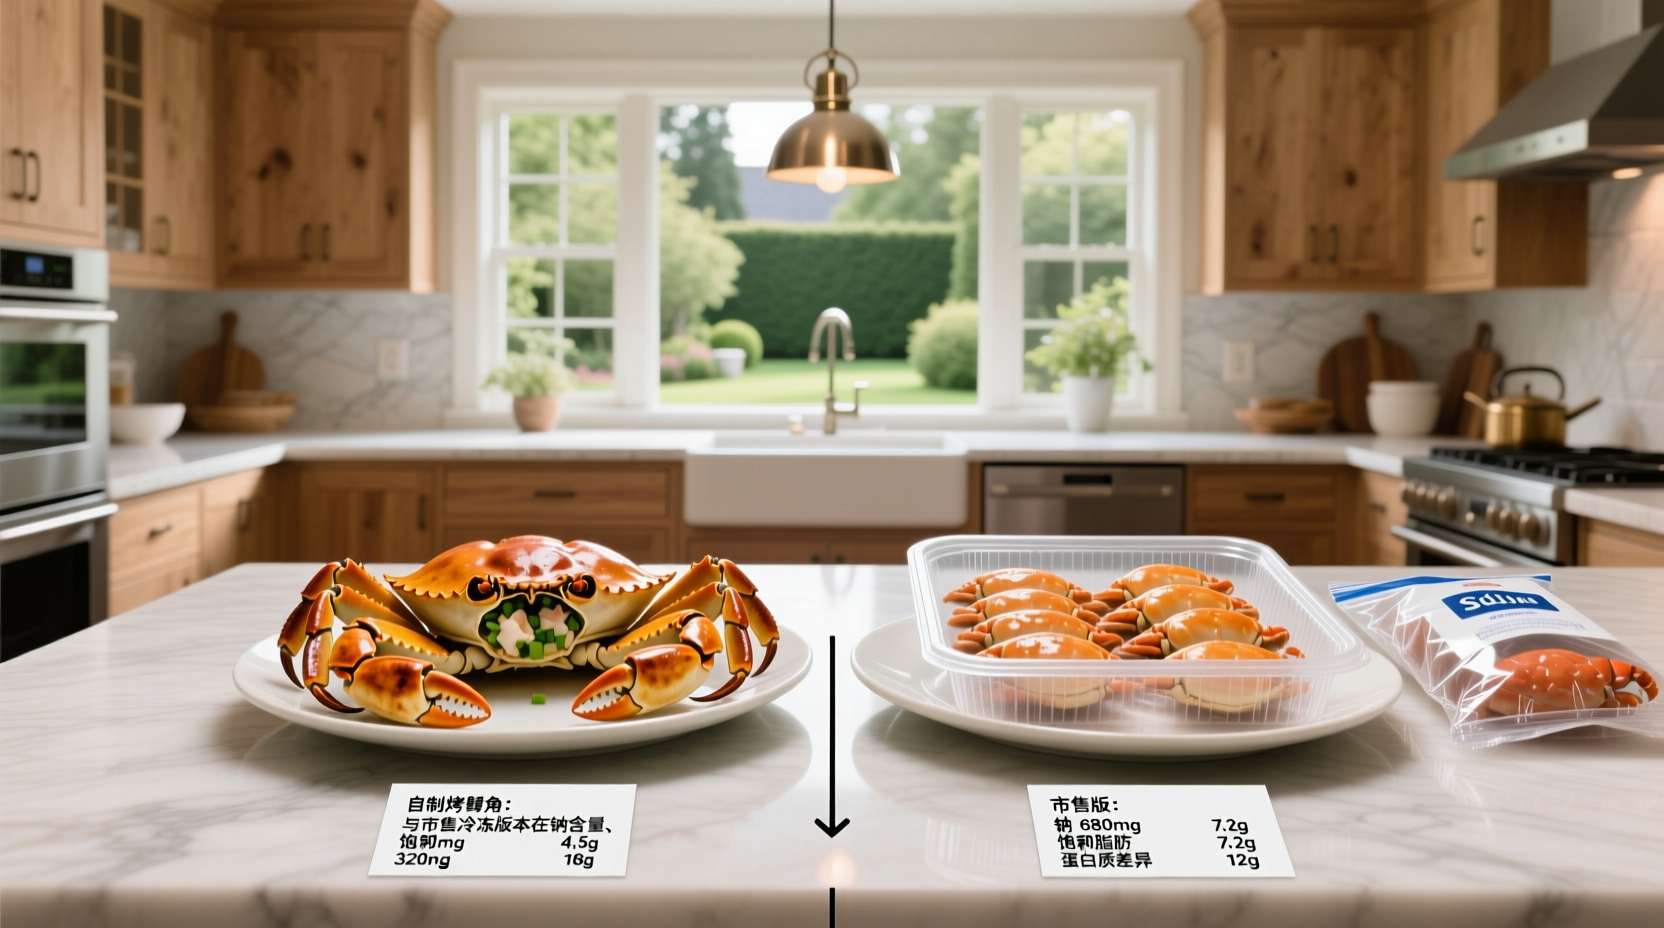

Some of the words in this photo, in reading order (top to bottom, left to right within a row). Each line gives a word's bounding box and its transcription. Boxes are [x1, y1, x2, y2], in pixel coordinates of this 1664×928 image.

[1079, 818, 1141, 835] 680mg
[1210, 818, 1249, 835] 7.2g
[1216, 835, 1257, 853] 7.2g
[393, 852, 451, 870] 320ng
[1226, 853, 1260, 870] 12g
